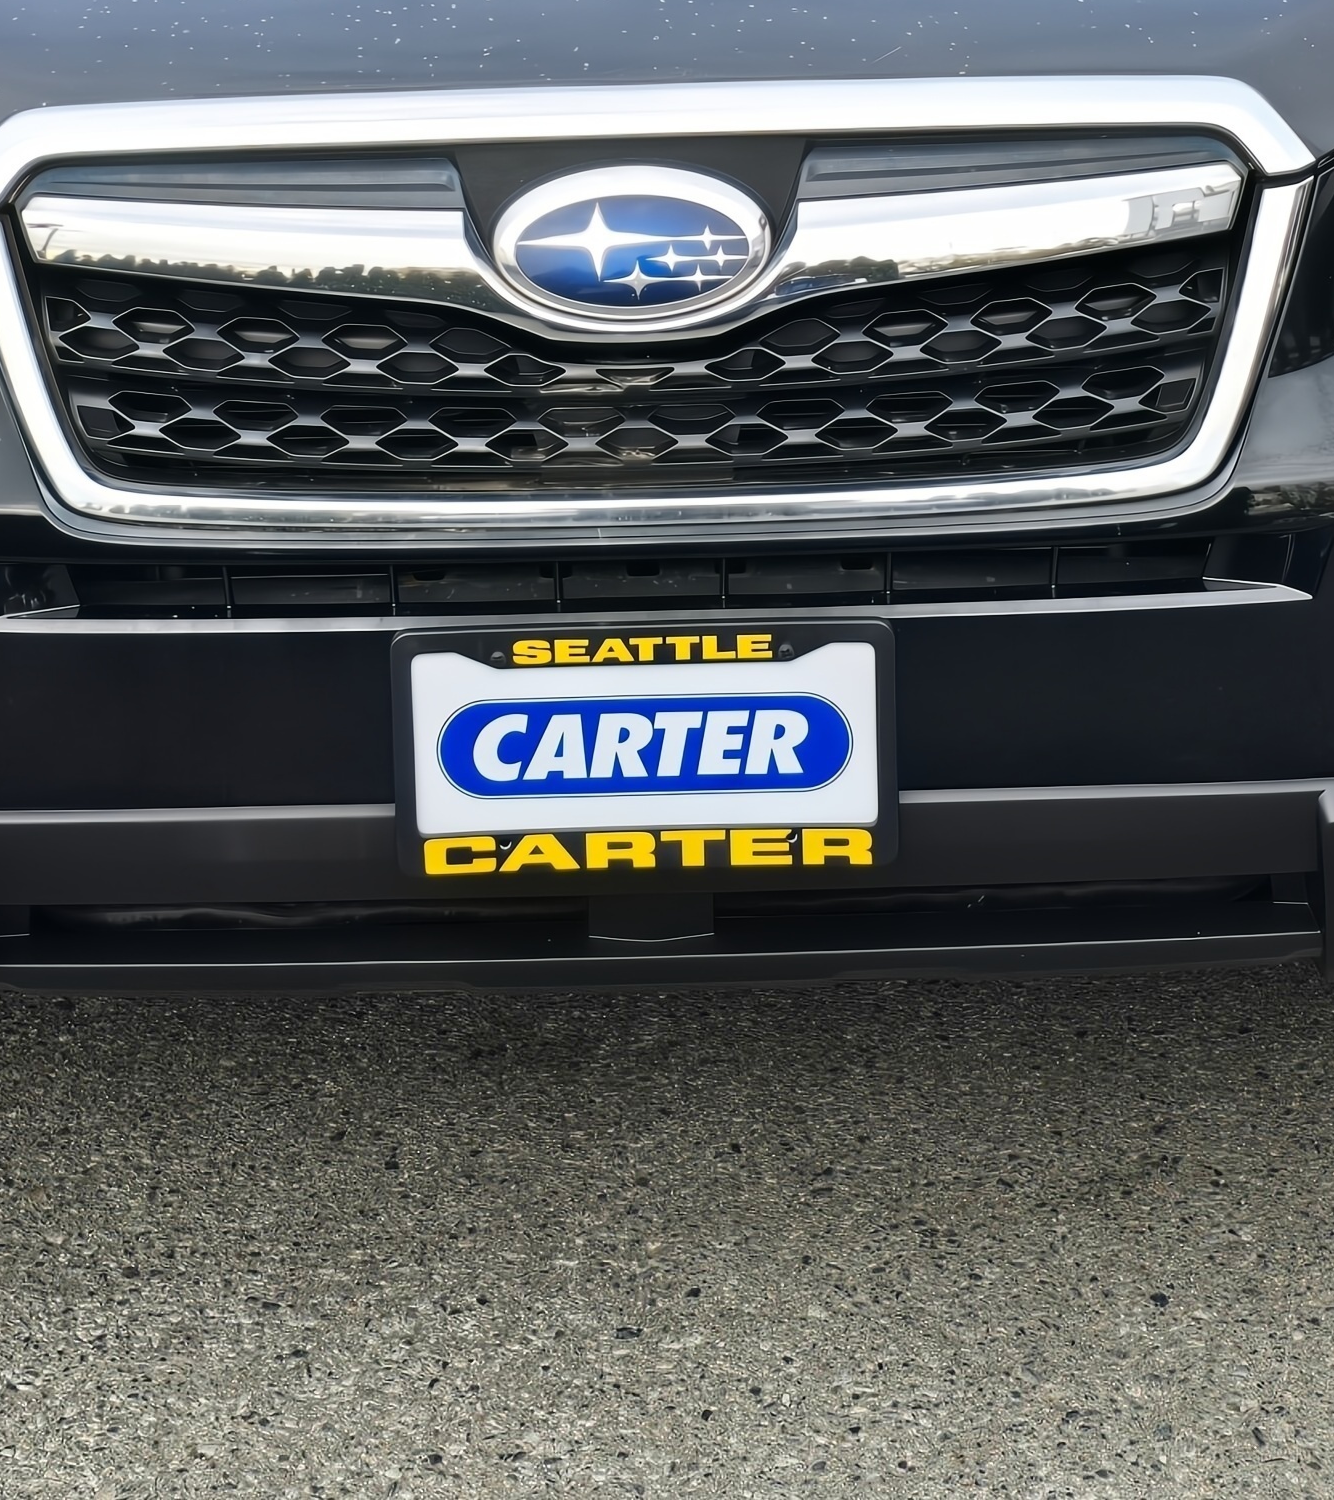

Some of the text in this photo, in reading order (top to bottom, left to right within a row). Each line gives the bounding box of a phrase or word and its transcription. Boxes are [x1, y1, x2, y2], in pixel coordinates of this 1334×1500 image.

[511, 633, 774, 666] SEATTLE
[472, 708, 810, 783] CARTER
[423, 827, 874, 876] CARTER
